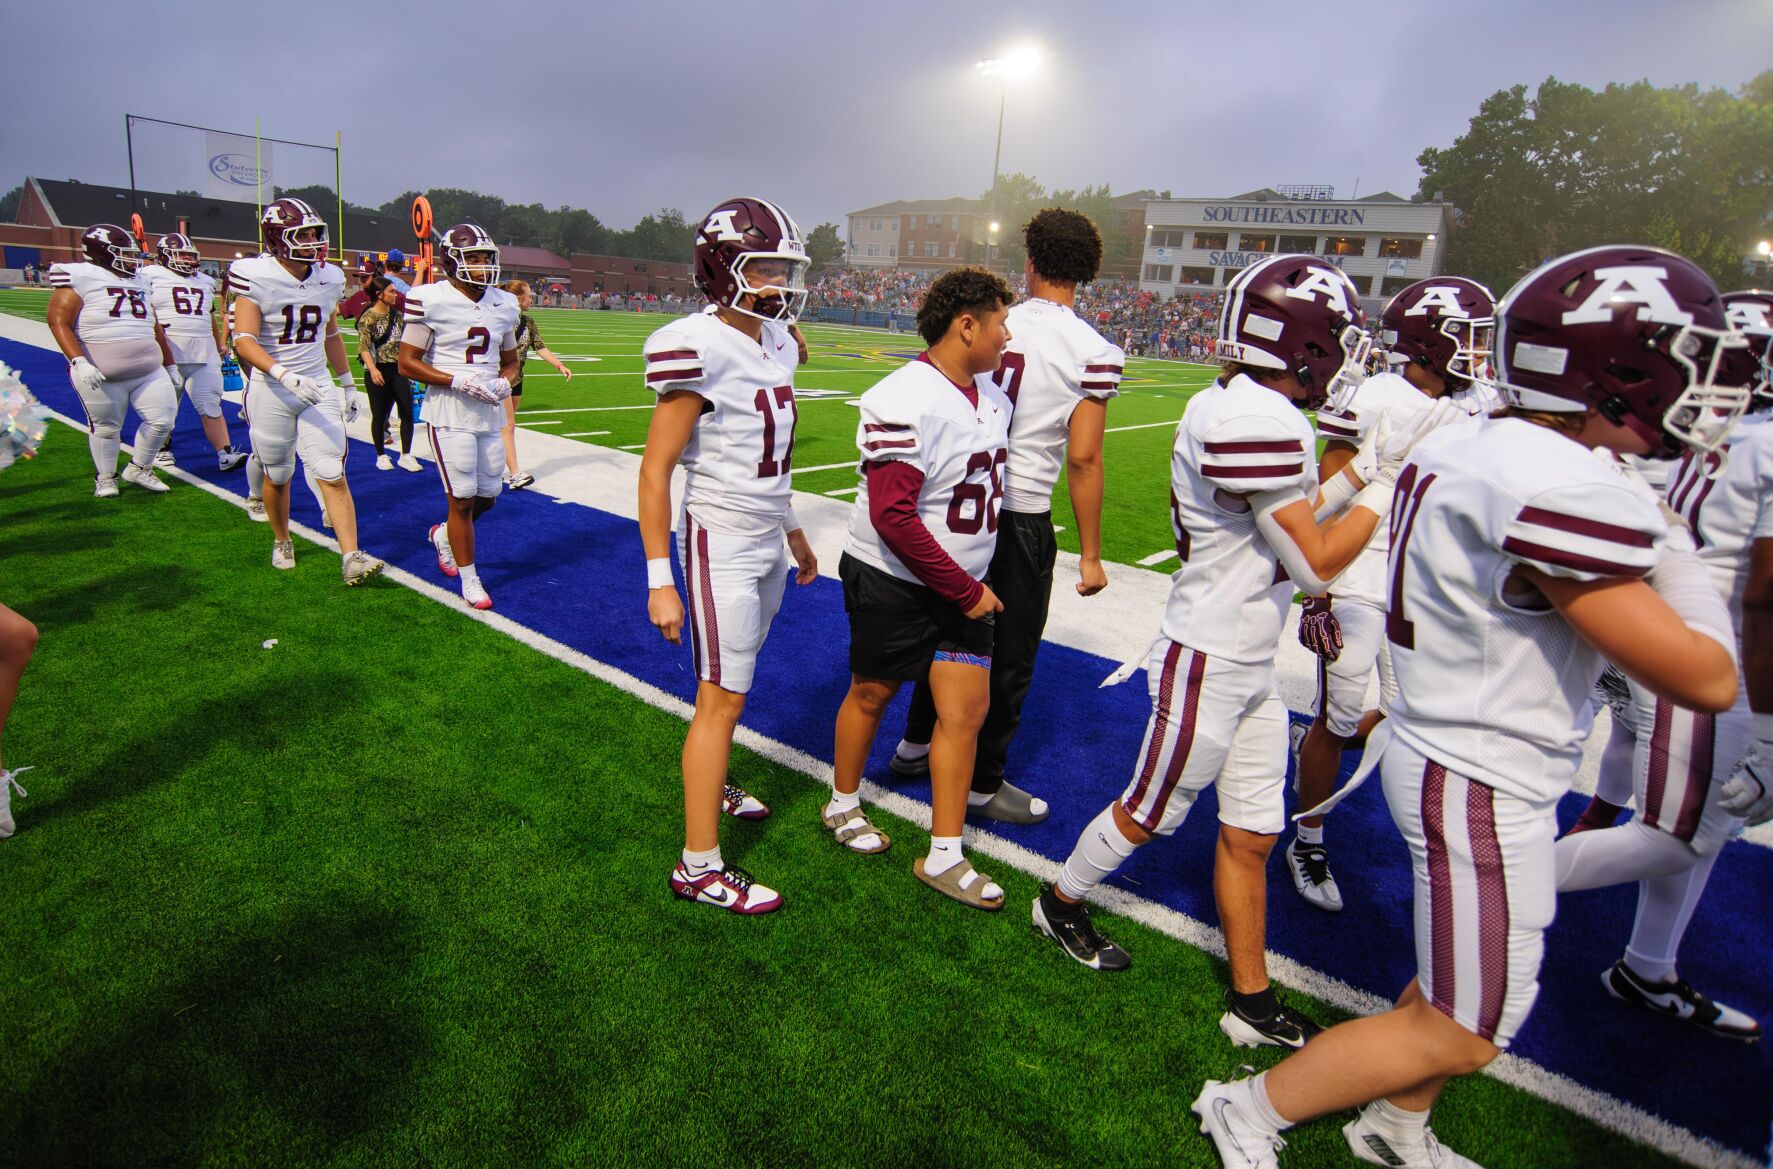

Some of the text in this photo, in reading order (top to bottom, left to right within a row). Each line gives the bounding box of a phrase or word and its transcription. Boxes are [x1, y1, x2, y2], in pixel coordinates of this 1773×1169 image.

[261, 206, 284, 225] A
[696, 210, 744, 246] A
[1202, 206, 1366, 225] SOUTHEASTERN
[87, 227, 112, 245] A
[172, 286, 205, 316] 67
[1286, 266, 1353, 321] A
[1405, 286, 1470, 319] A
[1562, 266, 1694, 325] A
[278, 304, 322, 345] 18
[466, 326, 491, 364] 2
[754, 385, 798, 478] 17
